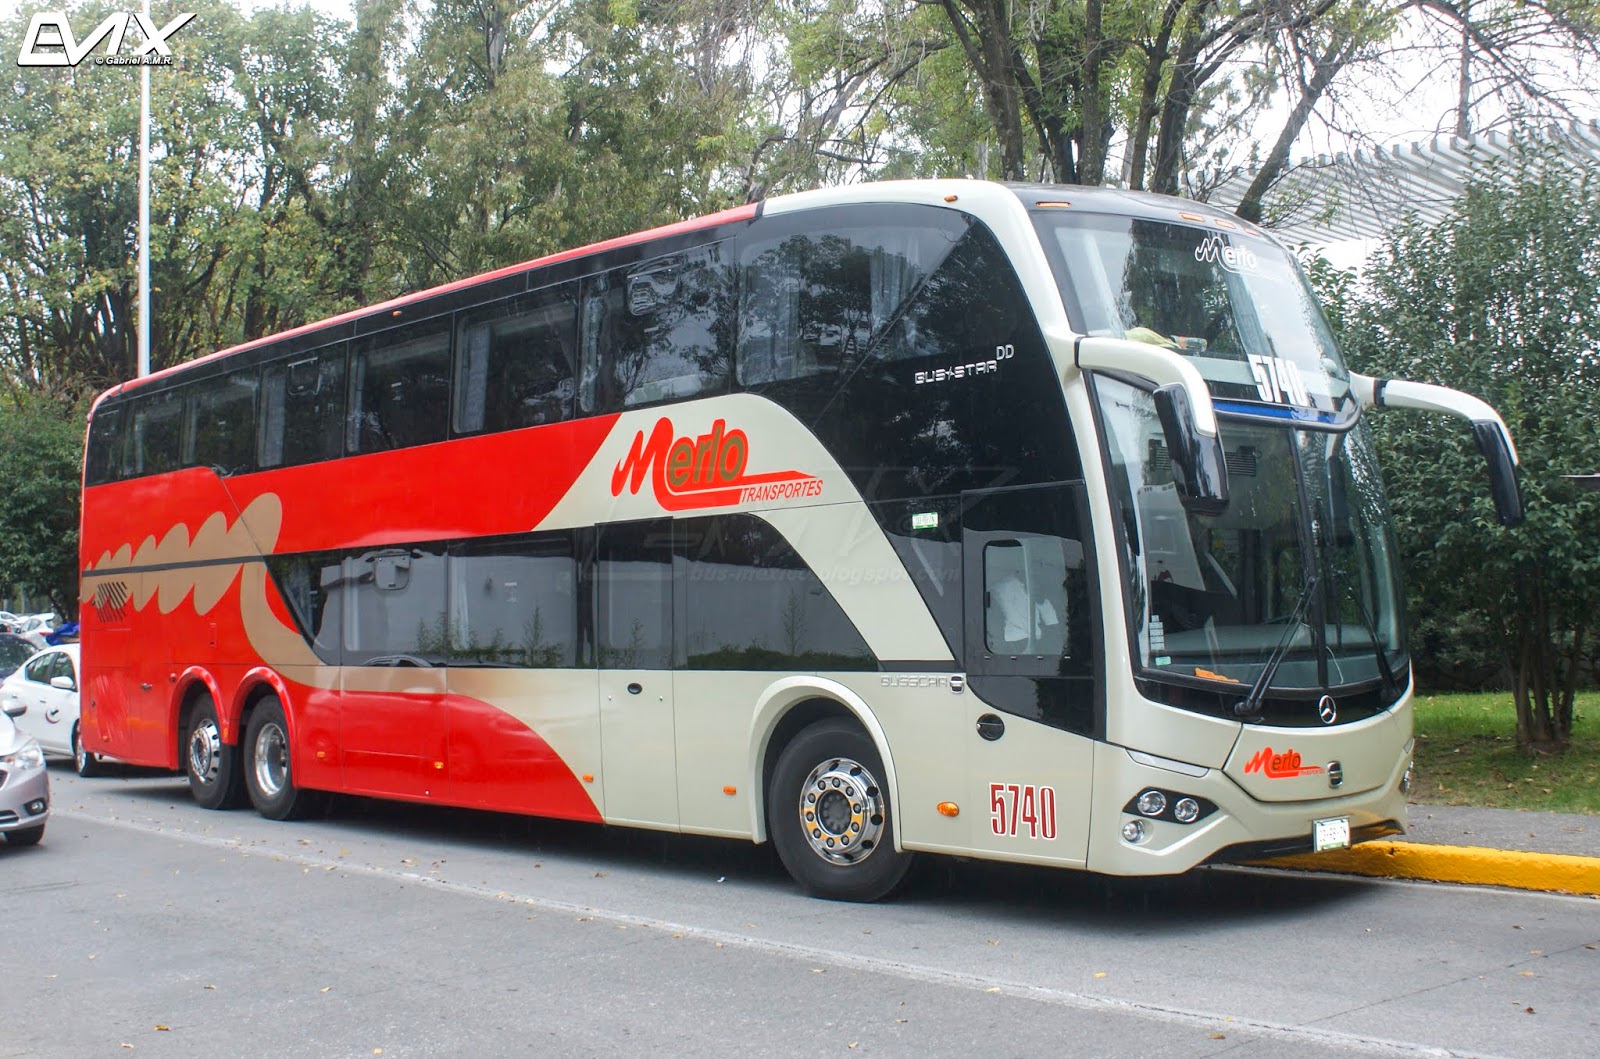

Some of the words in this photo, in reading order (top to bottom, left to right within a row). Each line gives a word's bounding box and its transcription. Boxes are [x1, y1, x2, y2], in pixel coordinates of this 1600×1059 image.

[1194, 236, 1258, 273] Merlo
[995, 343, 1015, 361] DD
[1247, 353, 1309, 407] 5740
[610, 416, 749, 512] Merlo
[740, 479, 824, 503] TRANSPORTES
[880, 674, 948, 688] BUSSCAR
[1243, 745, 1302, 779] Merlo
[988, 782, 1058, 841] 5740
